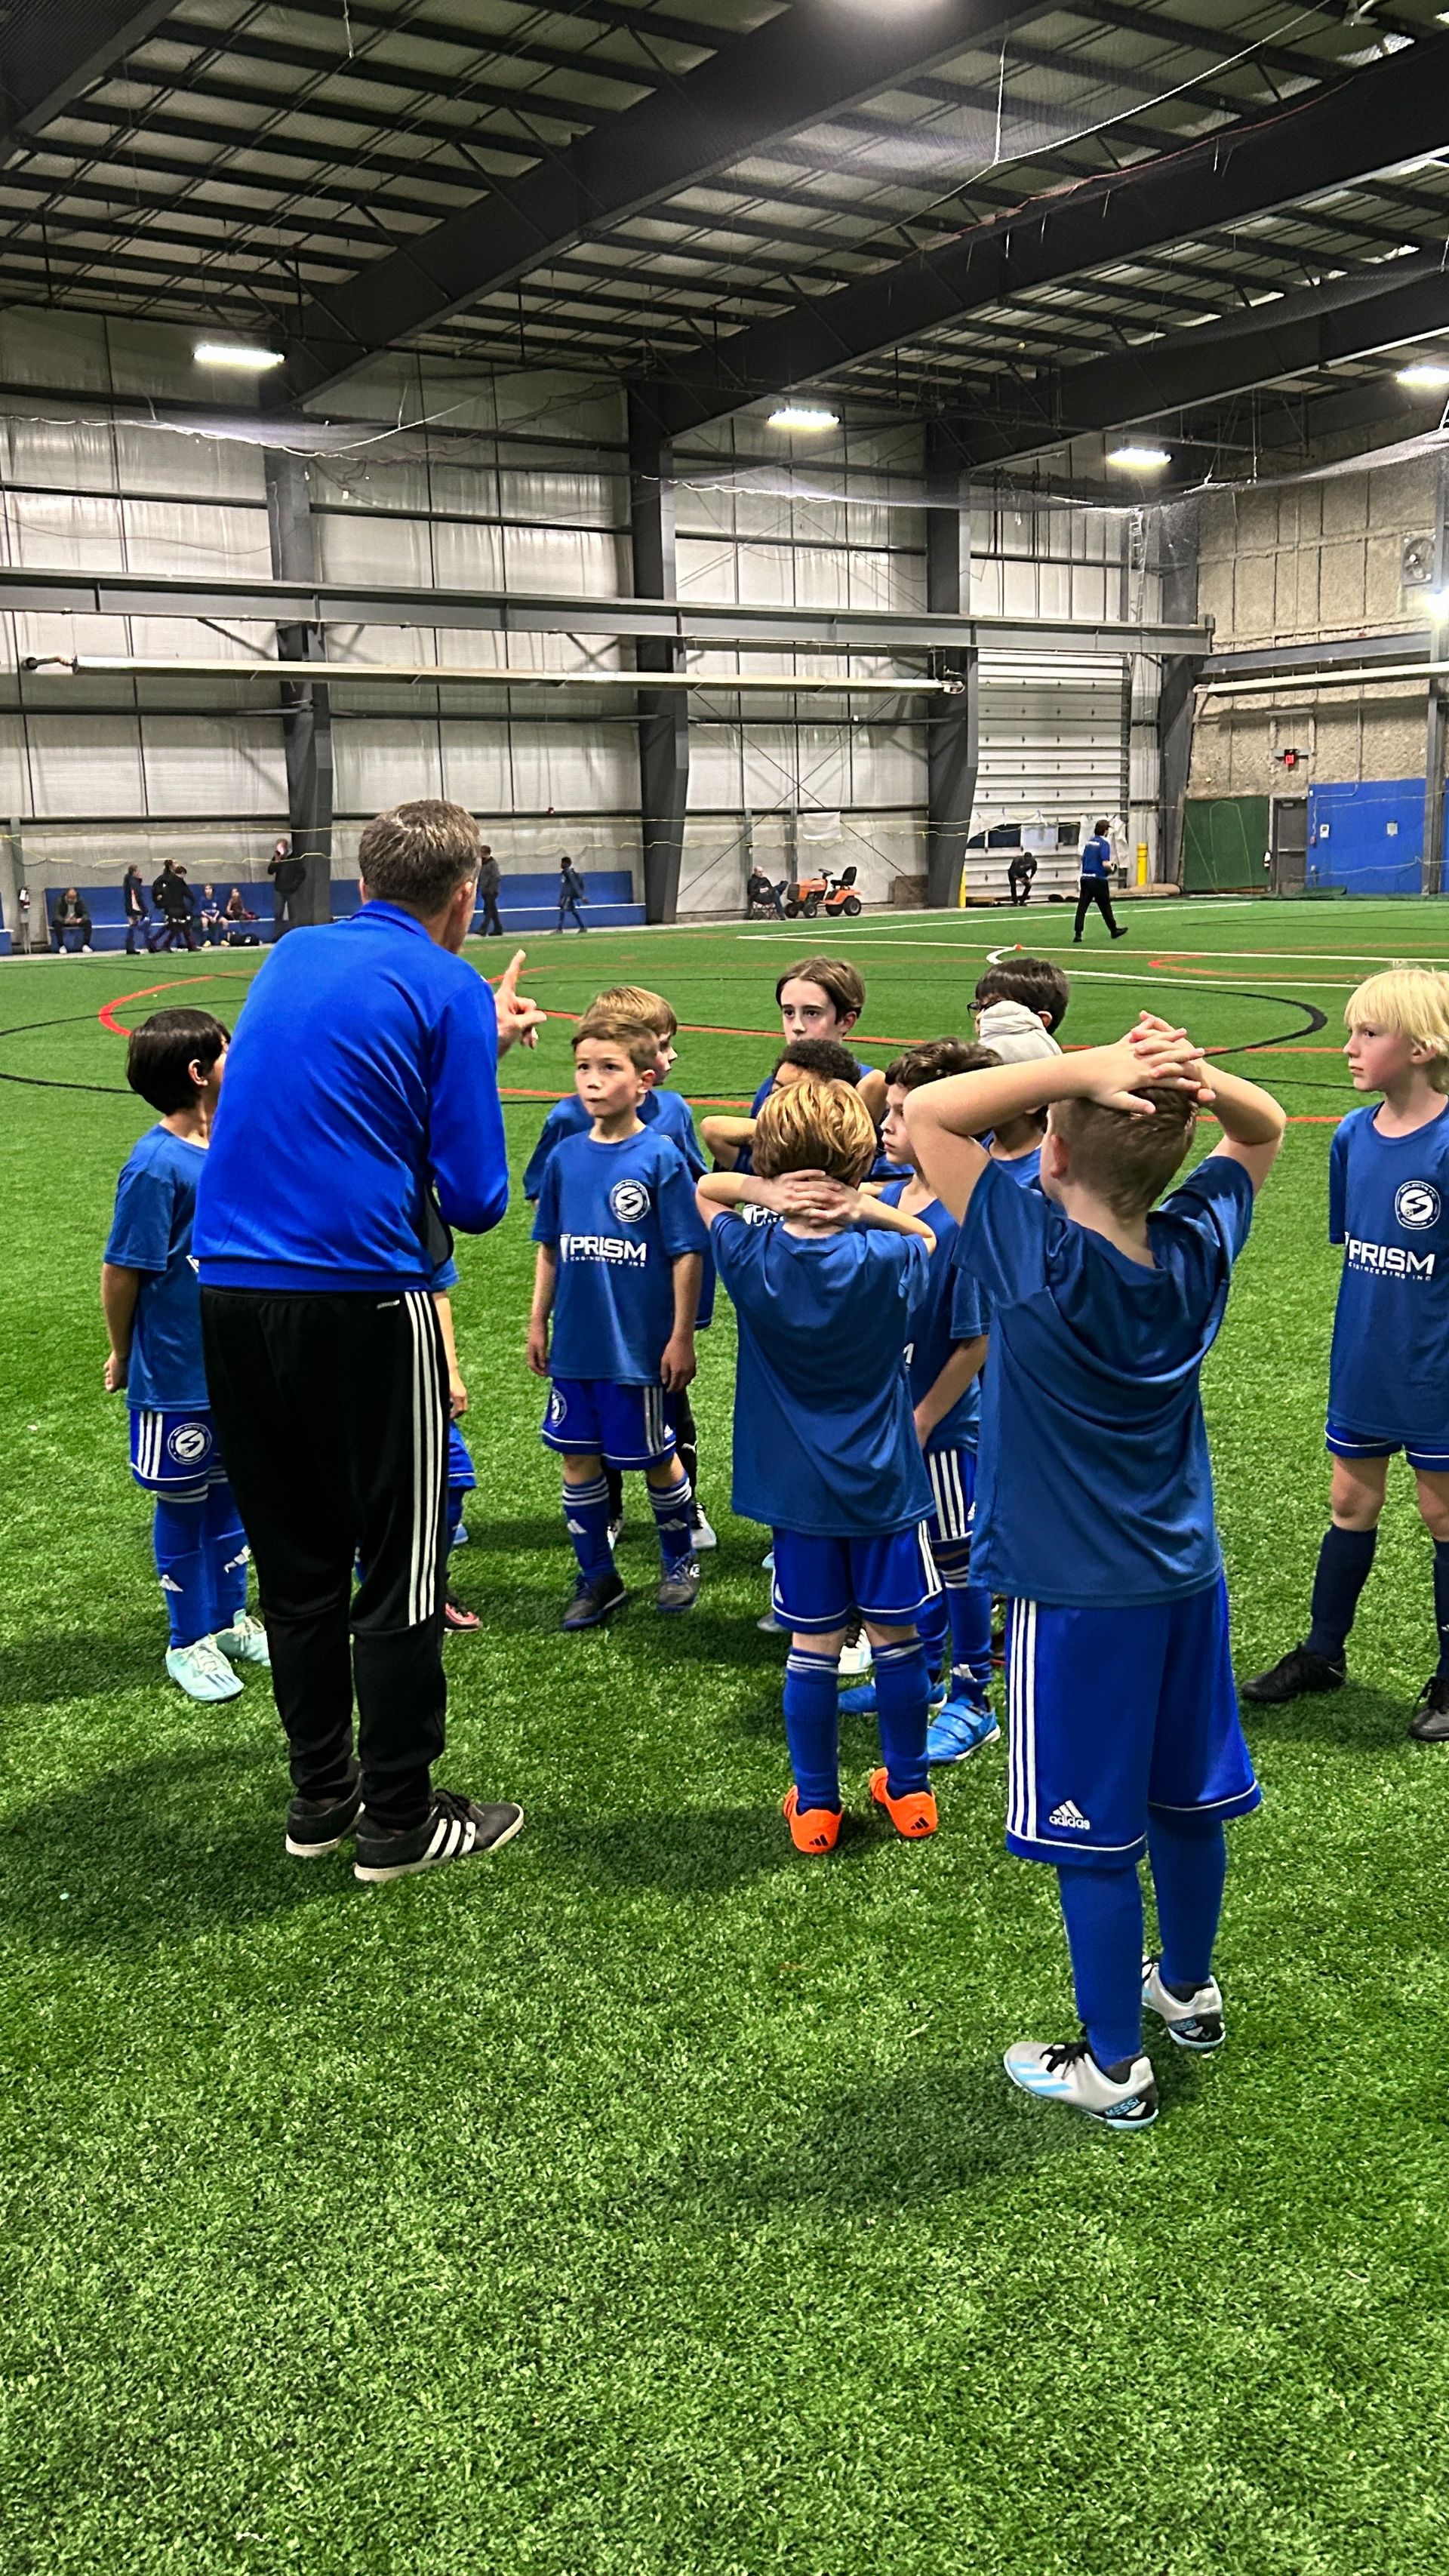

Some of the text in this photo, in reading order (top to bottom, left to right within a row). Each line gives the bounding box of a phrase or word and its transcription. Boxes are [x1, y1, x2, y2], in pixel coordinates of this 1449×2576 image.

[570, 1236, 648, 1261] PRISM
[1349, 1239, 1435, 1275] PRISM
[1048, 1814, 1091, 1830] adidas
[1104, 2096, 1140, 2118] MESSI
